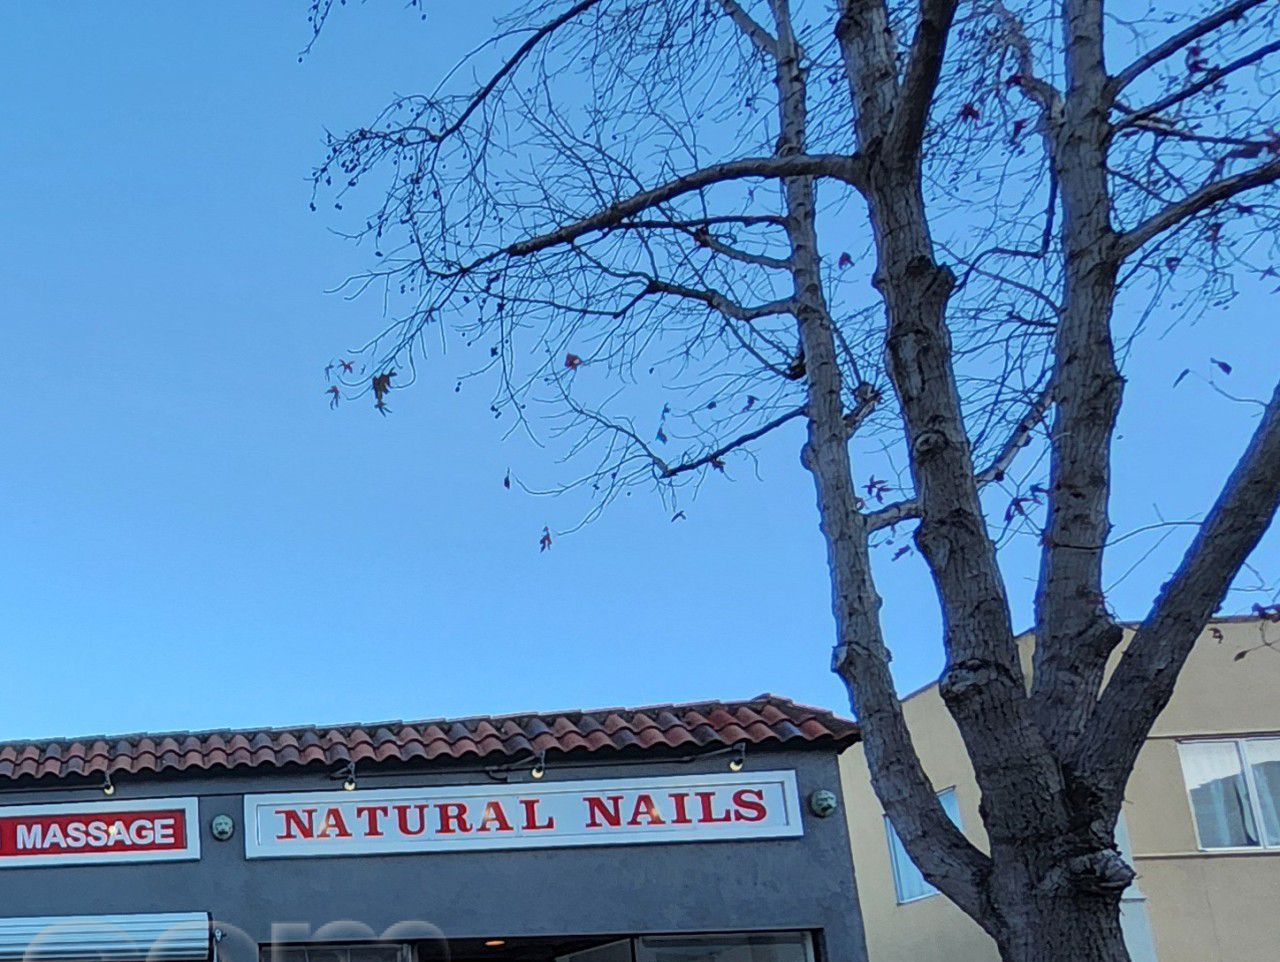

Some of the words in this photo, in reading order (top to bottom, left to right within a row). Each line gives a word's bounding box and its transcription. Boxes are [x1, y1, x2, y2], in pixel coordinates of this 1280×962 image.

[16, 817, 176, 850] MASSAGE
[274, 799, 555, 841] NATURAL
[583, 788, 768, 828] NAILS
